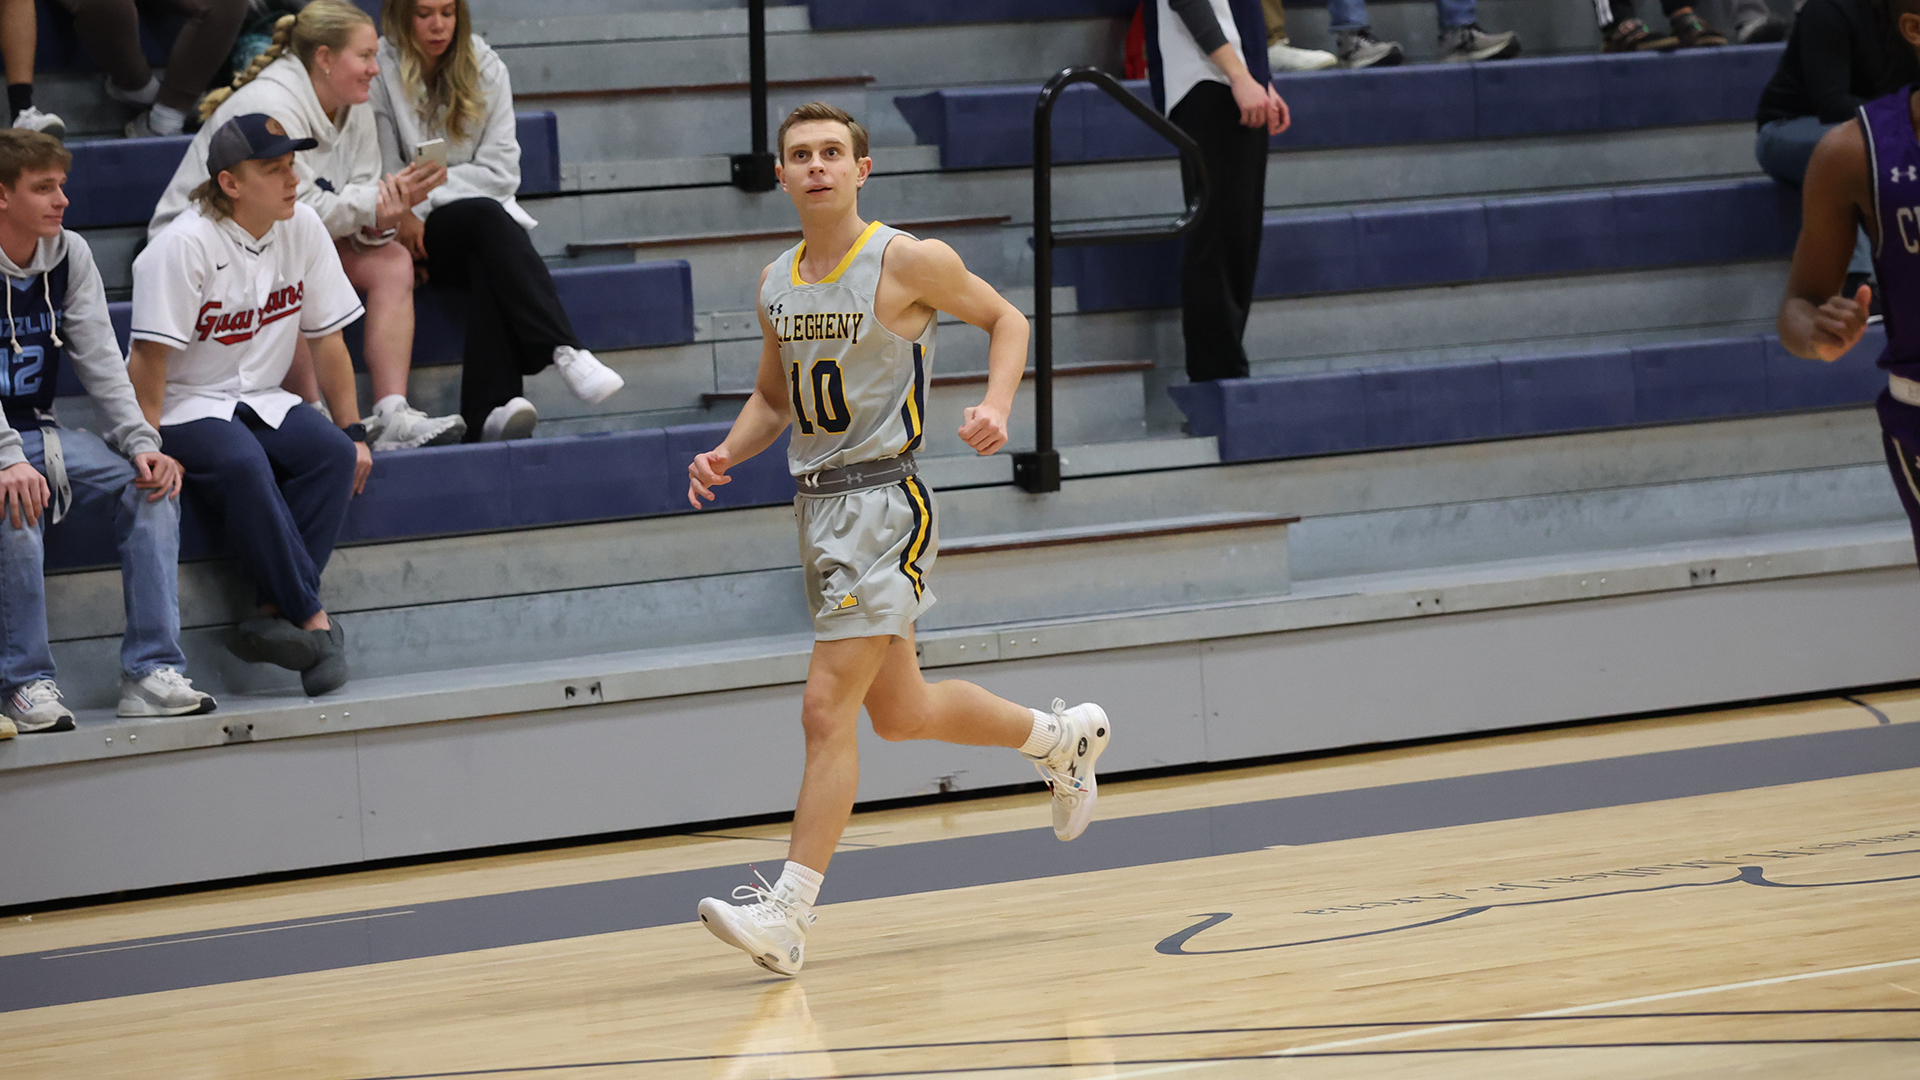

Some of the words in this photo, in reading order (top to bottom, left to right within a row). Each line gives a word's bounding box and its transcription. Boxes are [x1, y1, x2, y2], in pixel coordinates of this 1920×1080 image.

[195, 279, 304, 342] Guarans
[769, 312, 864, 349] LLEGHENY
[789, 358, 852, 436] 10
[1292, 892, 1470, 915] Arena
